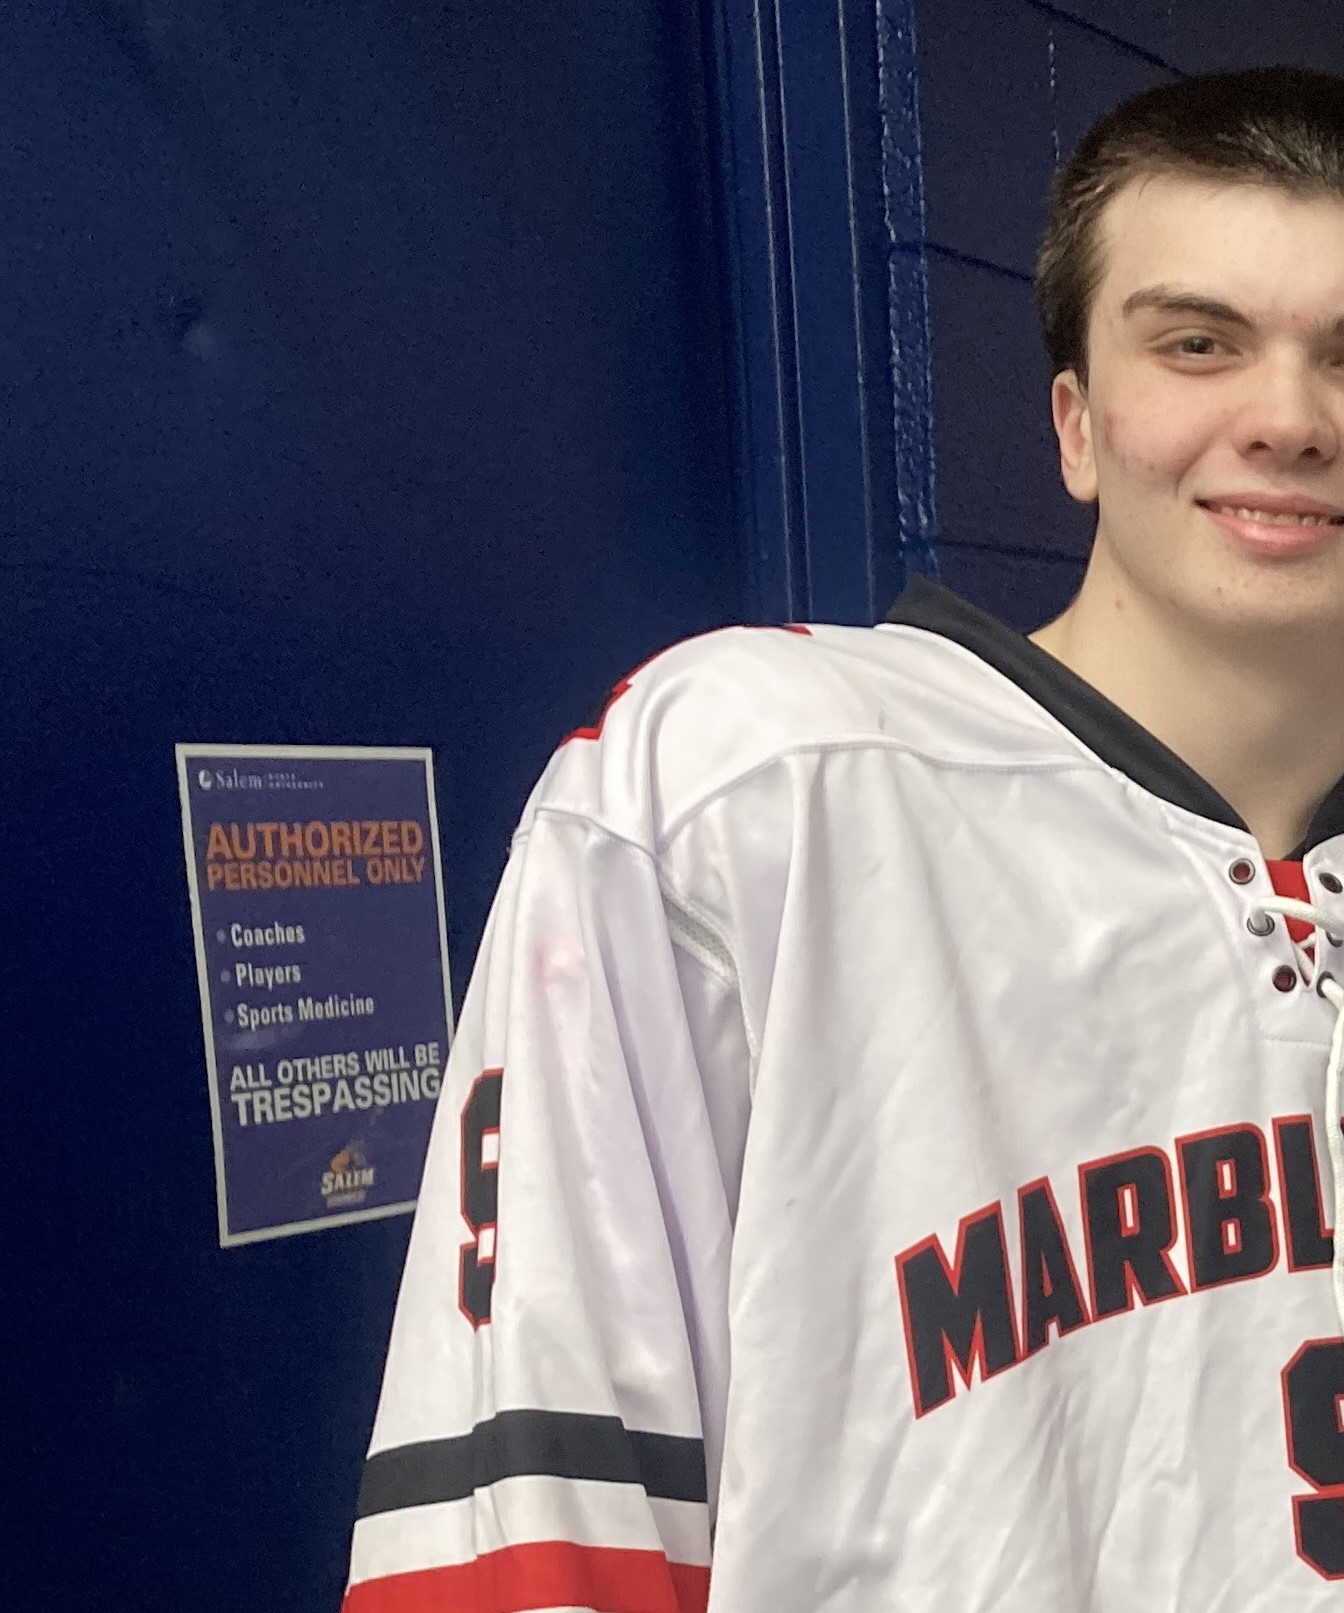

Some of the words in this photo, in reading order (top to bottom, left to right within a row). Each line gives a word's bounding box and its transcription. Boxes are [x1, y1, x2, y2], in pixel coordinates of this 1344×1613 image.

[207, 820, 423, 860] AUTHORIZED
[207, 859, 360, 891] PERSONNEL
[366, 856, 425, 884] ONLY
[231, 921, 305, 948] Coaches
[235, 963, 301, 992] Players
[237, 1003, 293, 1031] Sports
[298, 993, 375, 1021] Medicine
[230, 1064, 272, 1092] ALL
[277, 1052, 360, 1084] OTHERS
[365, 1046, 410, 1073] WILL
[414, 1042, 440, 1067] BE
[230, 1067, 440, 1127] TRESPASSING
